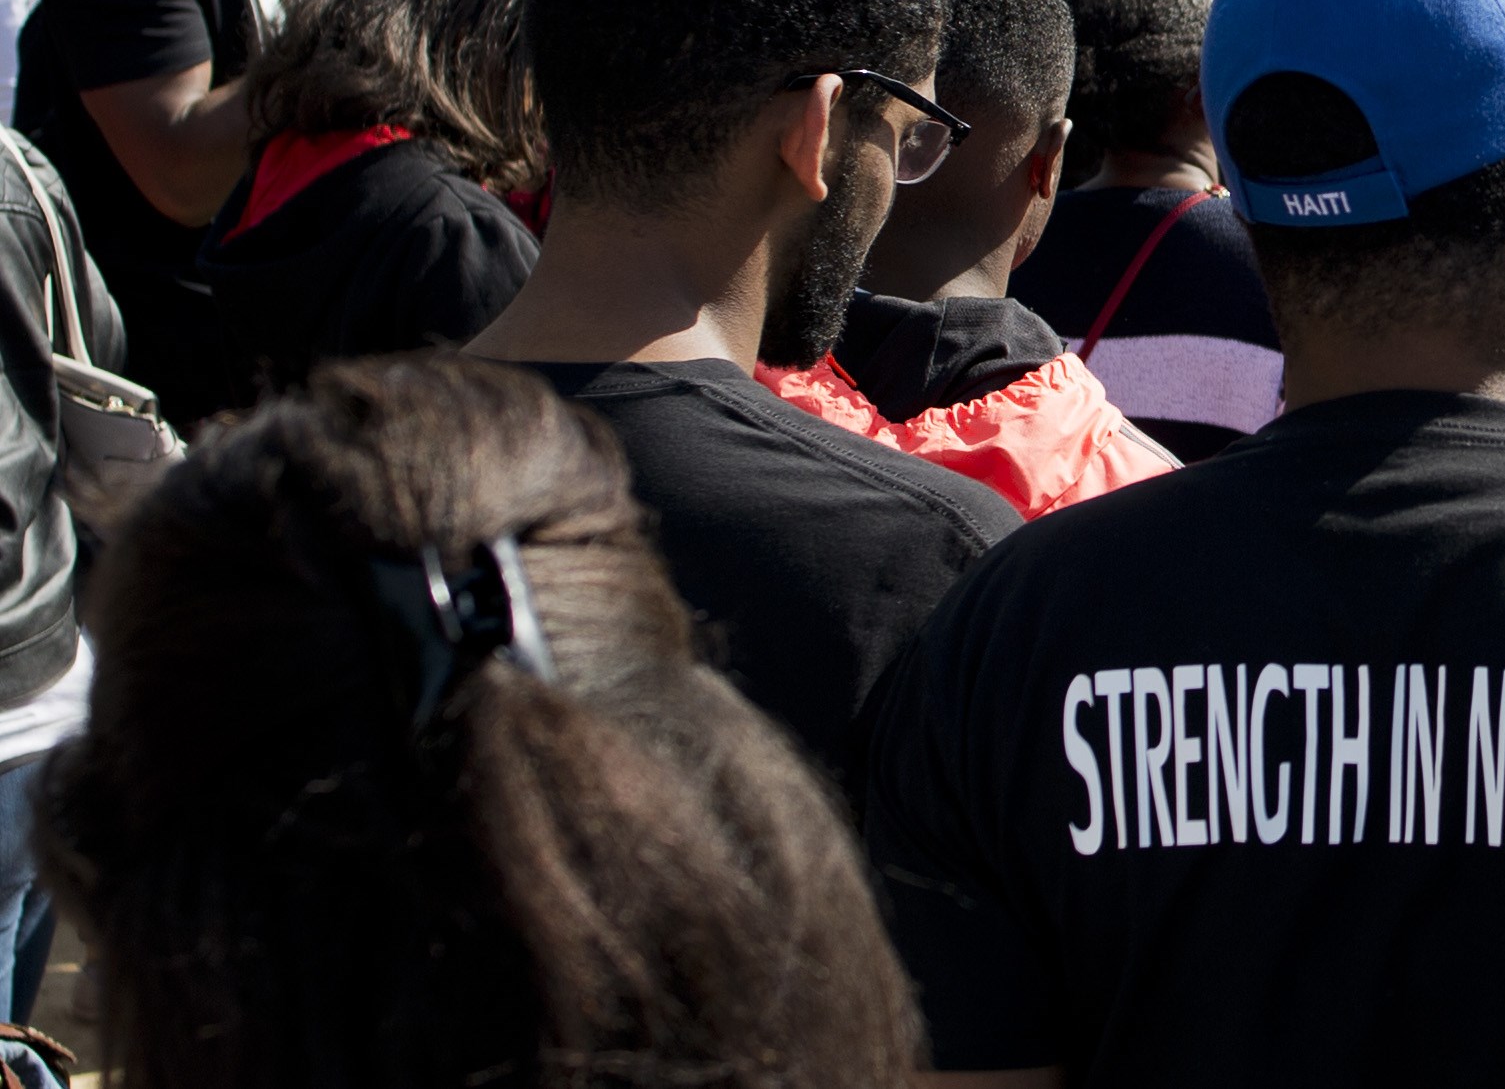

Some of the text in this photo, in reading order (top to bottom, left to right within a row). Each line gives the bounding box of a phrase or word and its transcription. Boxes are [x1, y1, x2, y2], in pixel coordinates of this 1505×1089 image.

[1284, 192, 1350, 215] HAITI
[1064, 663, 1369, 855] STRENGTH
[1389, 665, 1445, 844] IN
